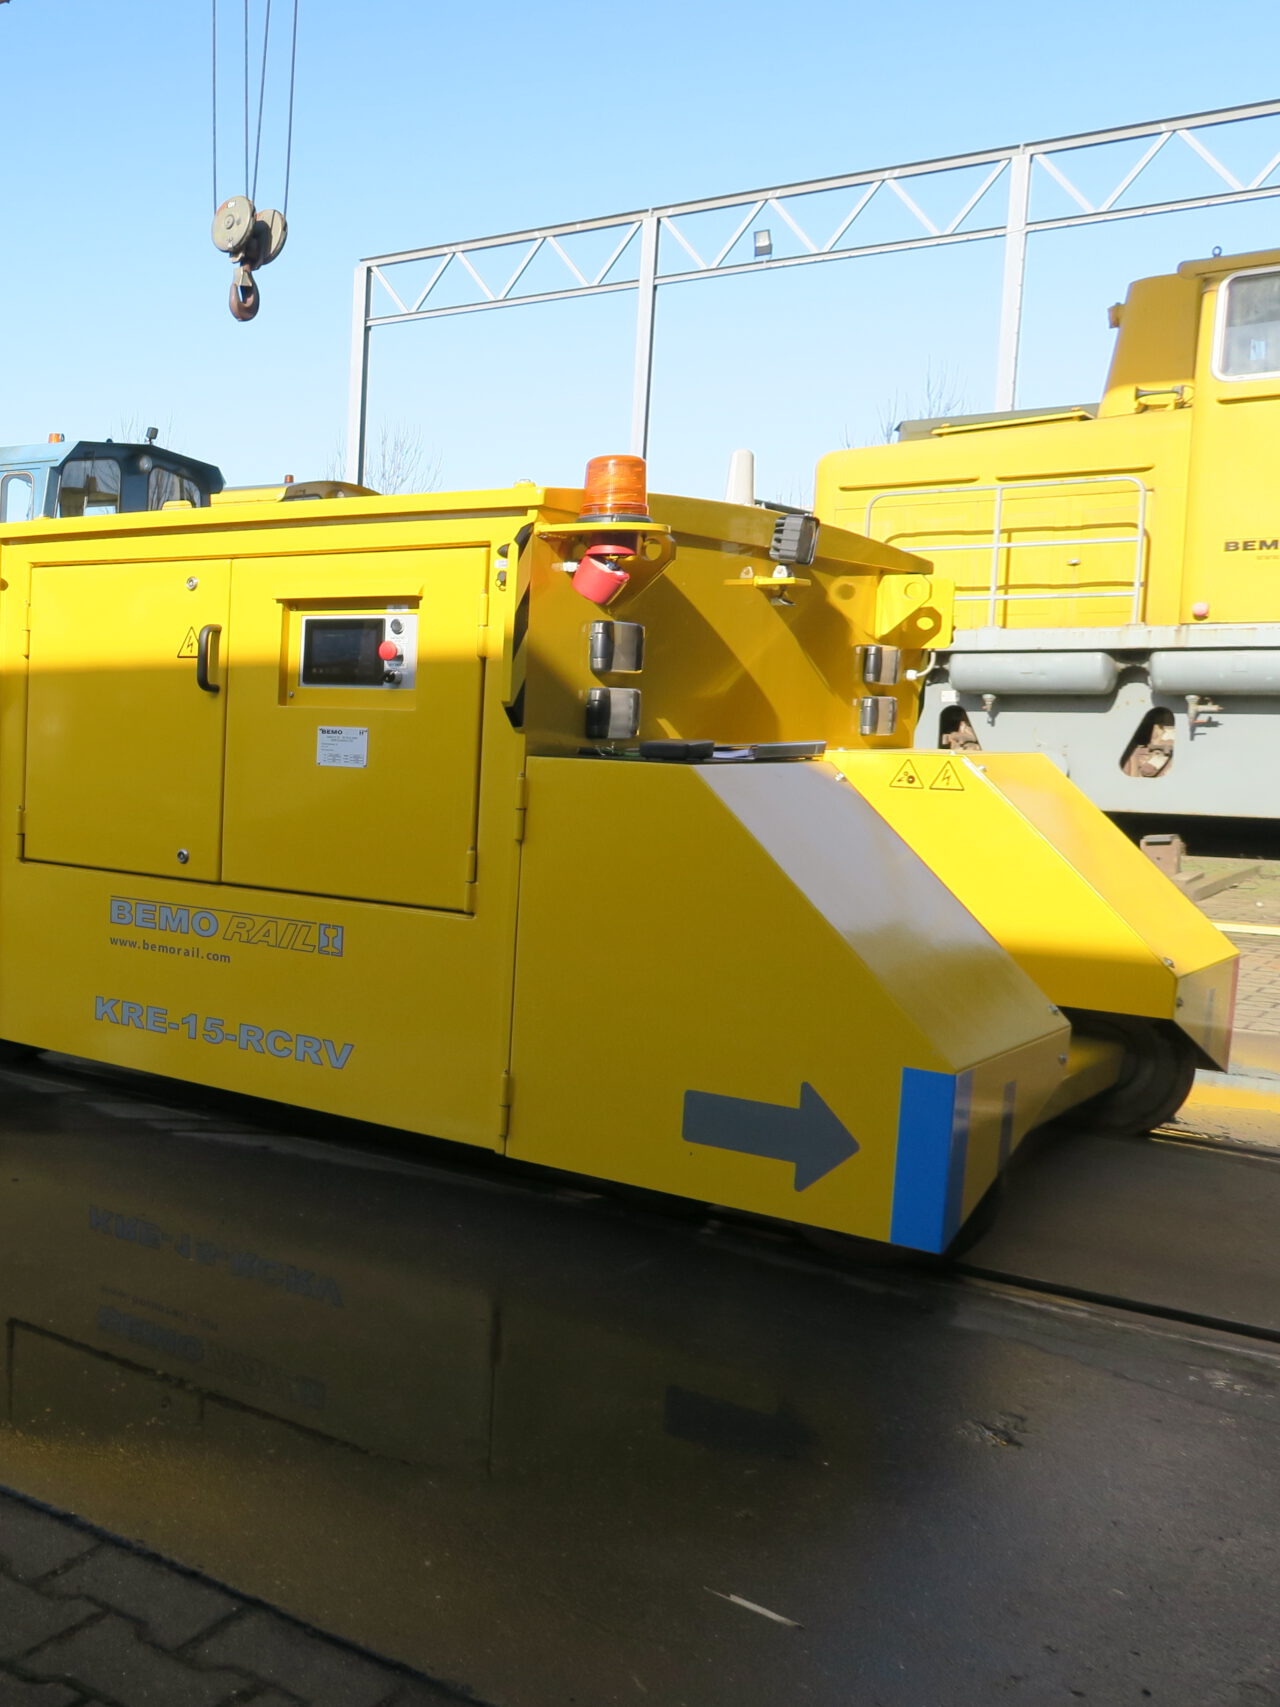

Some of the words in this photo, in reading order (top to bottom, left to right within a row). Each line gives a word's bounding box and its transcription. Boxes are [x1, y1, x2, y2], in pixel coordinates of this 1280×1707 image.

[109, 935, 231, 964] www.bemorail.com
[110, 899, 219, 938] BEMO
[223, 914, 317, 953] RAIL
[94, 995, 354, 1070] KRE-15-RCRV
